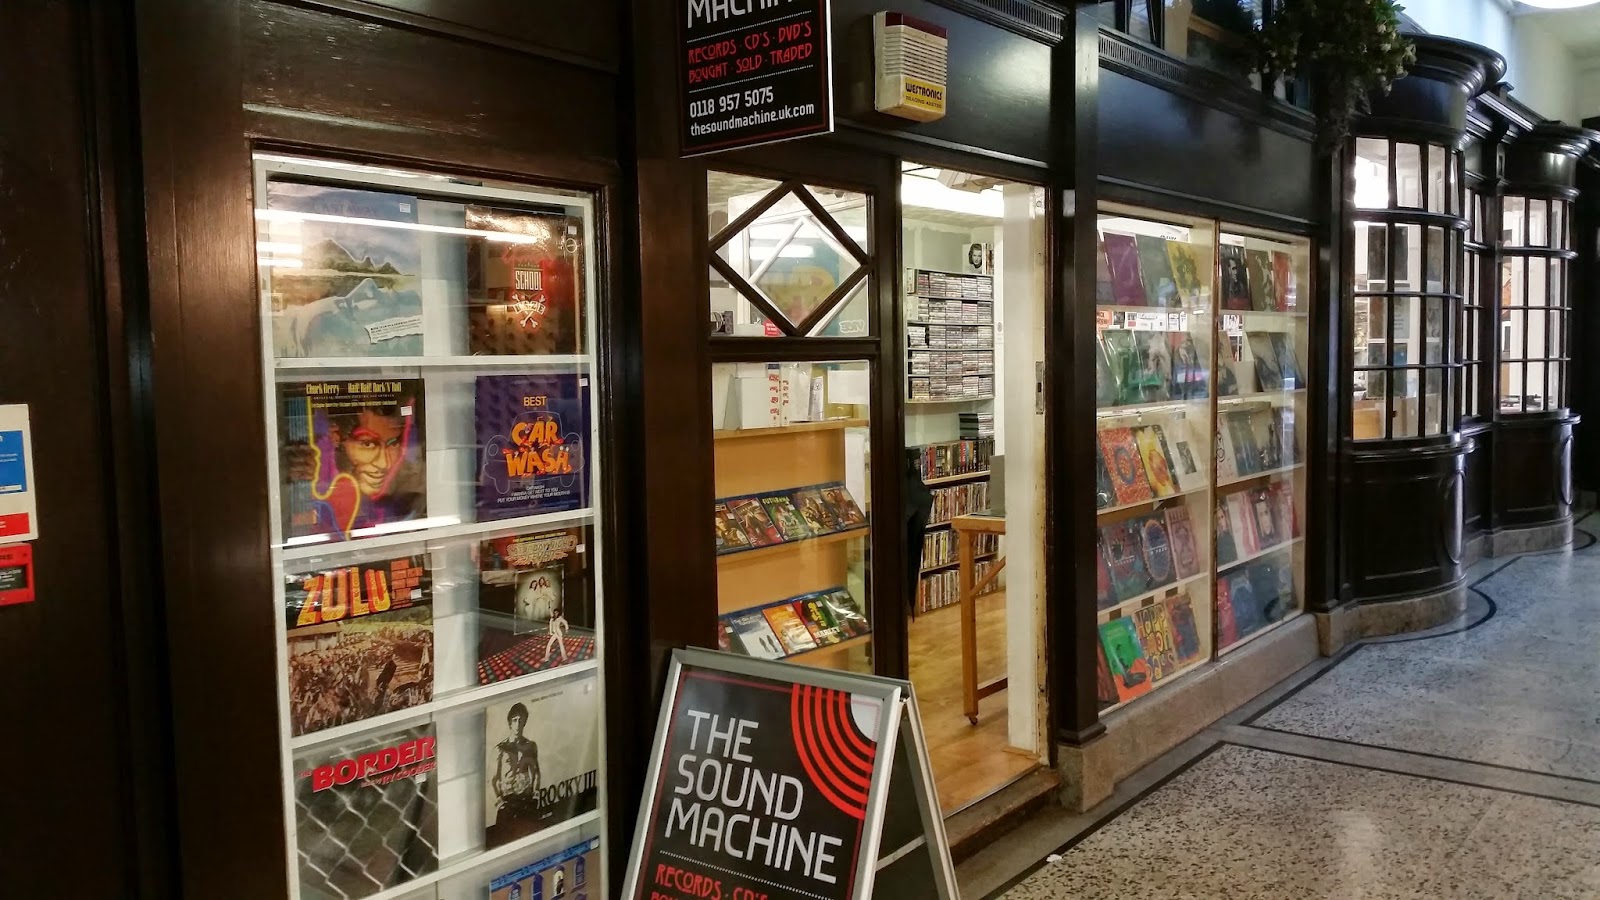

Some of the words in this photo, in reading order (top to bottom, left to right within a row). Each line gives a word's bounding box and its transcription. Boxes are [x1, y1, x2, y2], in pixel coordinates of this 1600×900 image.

[688, 39, 737, 64] RECORDS
[744, 31, 770, 50] CD'S
[778, 21, 812, 43] DVD'S
[688, 62, 728, 84] BOUGHT
[736, 54, 762, 74] SOLD
[769, 43, 812, 65] TRADED
[689, 98, 715, 118] 0118
[719, 92, 740, 112] 957
[744, 86, 774, 107] 5075
[905, 82, 943, 100] WESTRONICS
[690, 103, 815, 136] thesoundmachine.uk.com
[515, 270, 543, 291] SCHOOL
[305, 383, 323, 395] Chuck
[323, 383, 340, 396] Berry
[372, 382, 386, 393] Rock
[523, 396, 547, 407] BEST
[511, 420, 560, 446] CAR
[505, 448, 572, 477] WASH
[296, 566, 391, 626] ZULU
[686, 709, 759, 763] THE
[312, 736, 436, 793] BORDER
[539, 775, 582, 808] ROCKY
[579, 769, 597, 793] III
[673, 754, 804, 821] SOUND
[664, 797, 843, 884] MACHINE
[655, 863, 722, 900] RECORDS
